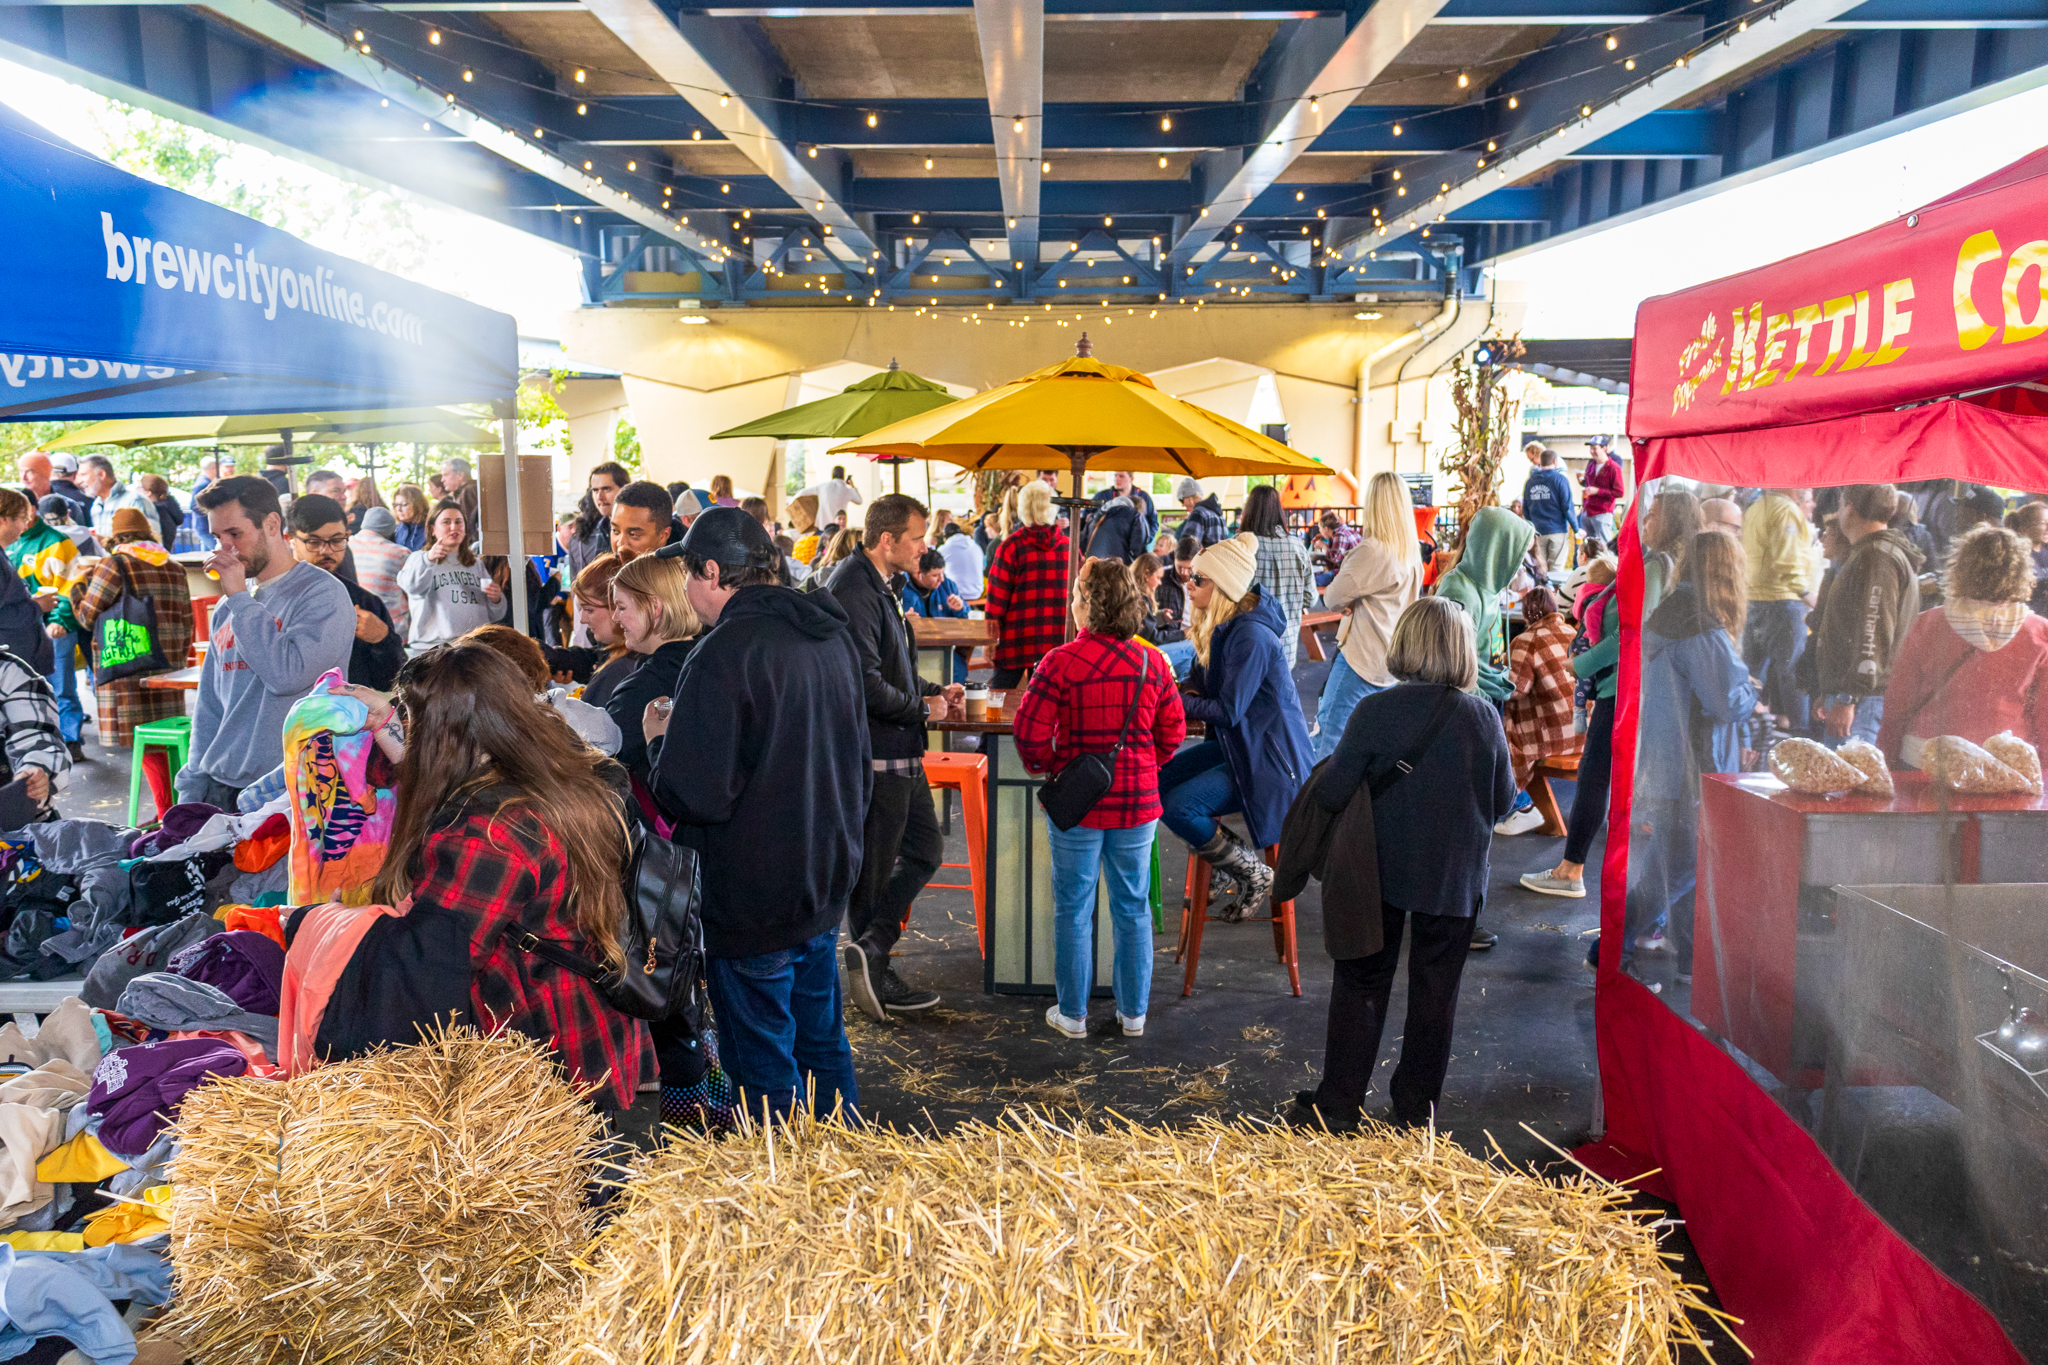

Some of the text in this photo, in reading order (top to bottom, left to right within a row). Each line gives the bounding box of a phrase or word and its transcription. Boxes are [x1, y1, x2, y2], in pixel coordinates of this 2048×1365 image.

[101, 211, 425, 346] brewcityonline.com
[1720, 277, 1915, 396] KETTLE
[451, 589, 479, 605] USA
